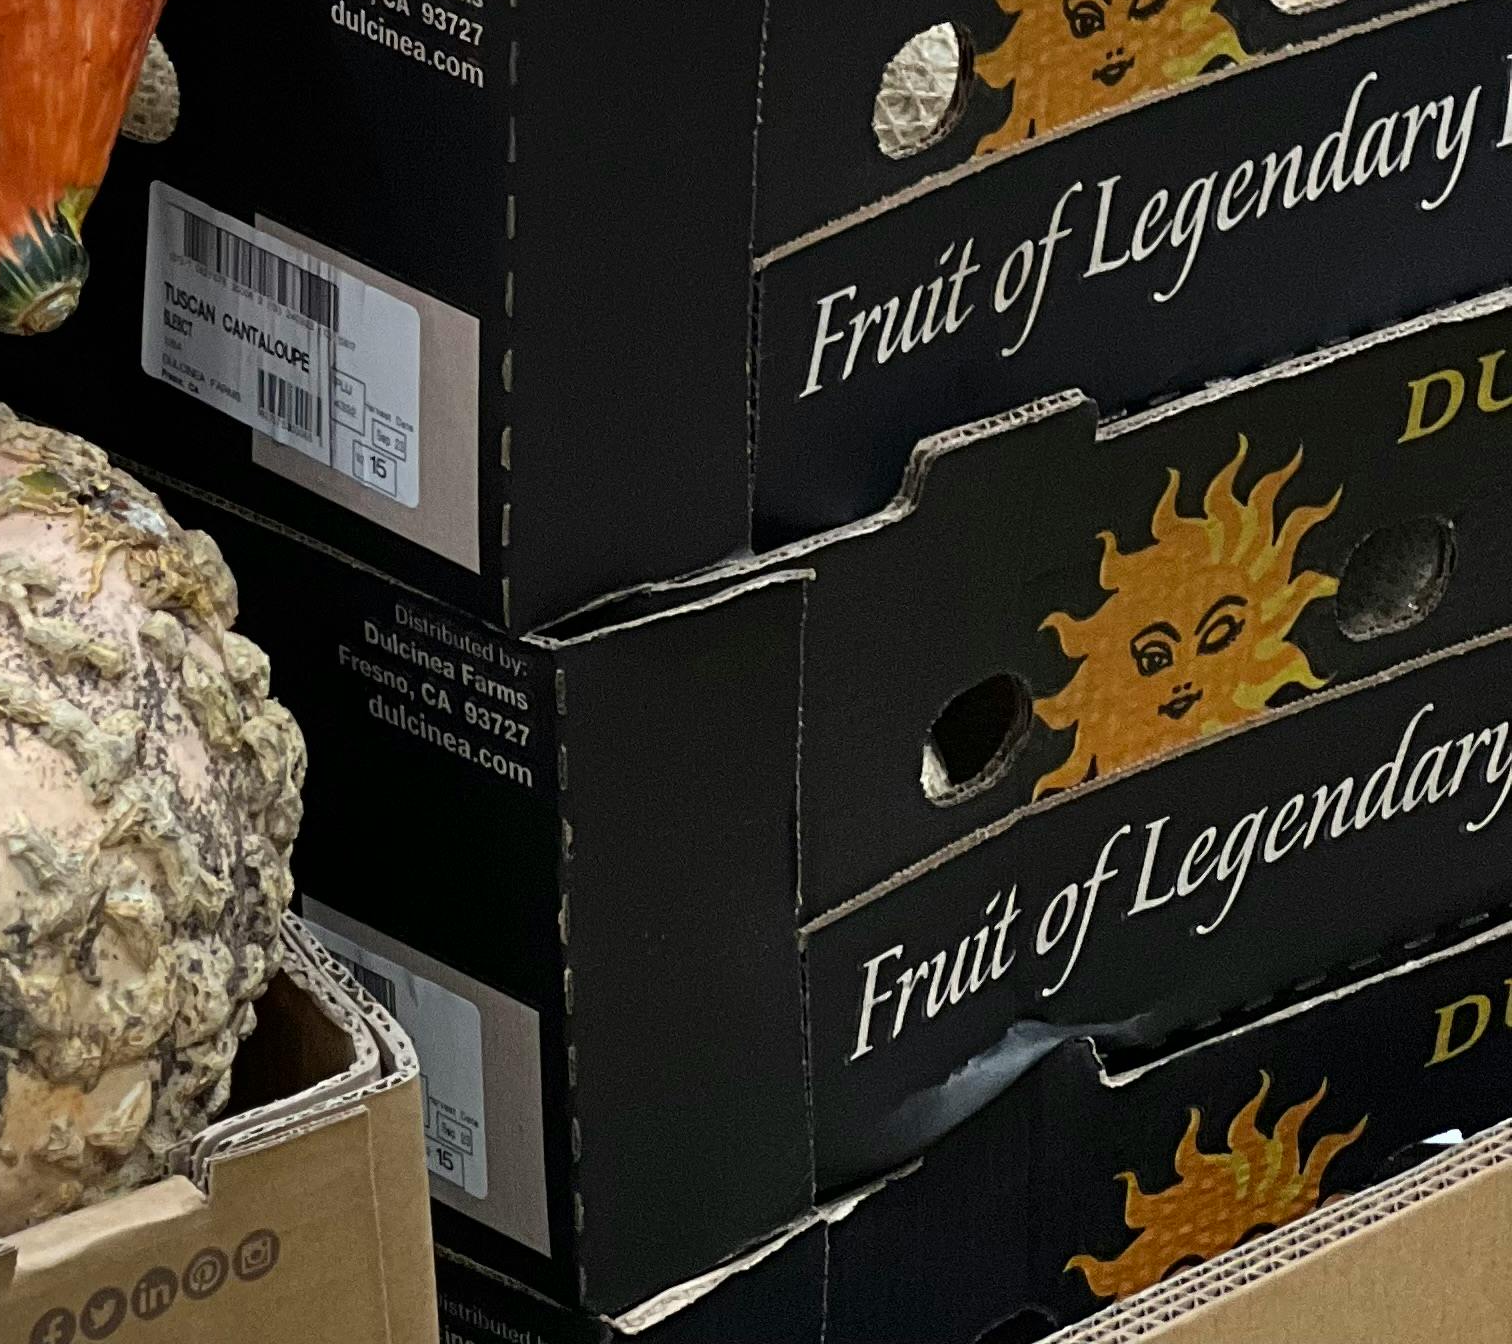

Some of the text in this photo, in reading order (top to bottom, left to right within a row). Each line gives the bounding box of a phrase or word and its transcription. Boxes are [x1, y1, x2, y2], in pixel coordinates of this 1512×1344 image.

[330, 0, 484, 88] dulcinea.com
[421, 2, 484, 46] 93727
[799, 236, 981, 400] Fruit
[994, 180, 1084, 358] of
[1083, 70, 1483, 304] Legendary
[164, 281, 217, 325] TUSCAN
[222, 313, 310, 374] CANTALOUPE
[370, 456, 387, 479] 15
[364, 620, 528, 710] Dulcinea Farms
[395, 603, 528, 676] Distributed by:
[338, 644, 530, 747] Fresno, CA 93727
[368, 694, 533, 788] dulcinea.com
[850, 702, 1512, 1063] Fruit of Legendary
[436, 1148, 454, 1171] 15
[440, 1293, 531, 1344] istributed
